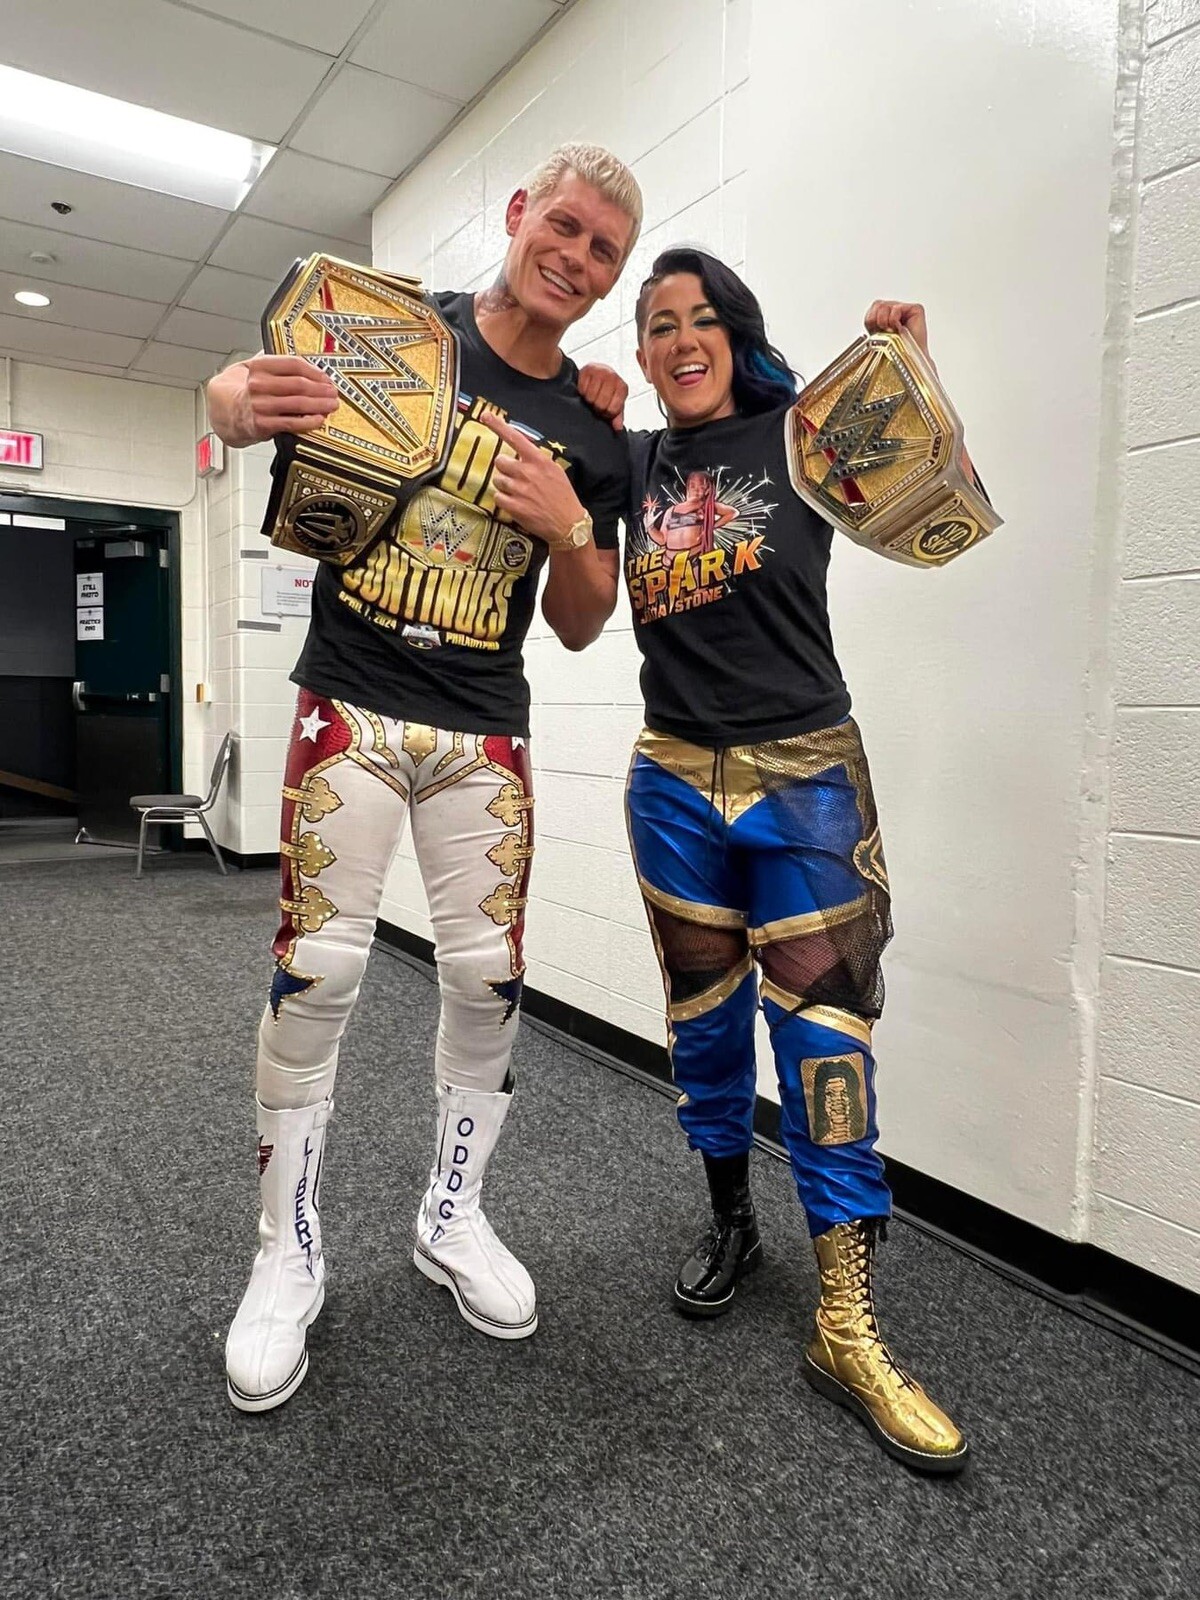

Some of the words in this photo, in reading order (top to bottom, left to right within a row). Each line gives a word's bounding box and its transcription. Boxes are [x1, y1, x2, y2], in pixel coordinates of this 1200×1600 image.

[0, 434, 35, 464] XIT
[627, 549, 666, 577] THE
[629, 535, 765, 610] SPARK
[674, 584, 724, 614] STONE
[294, 1135, 316, 1281] LIBERTY
